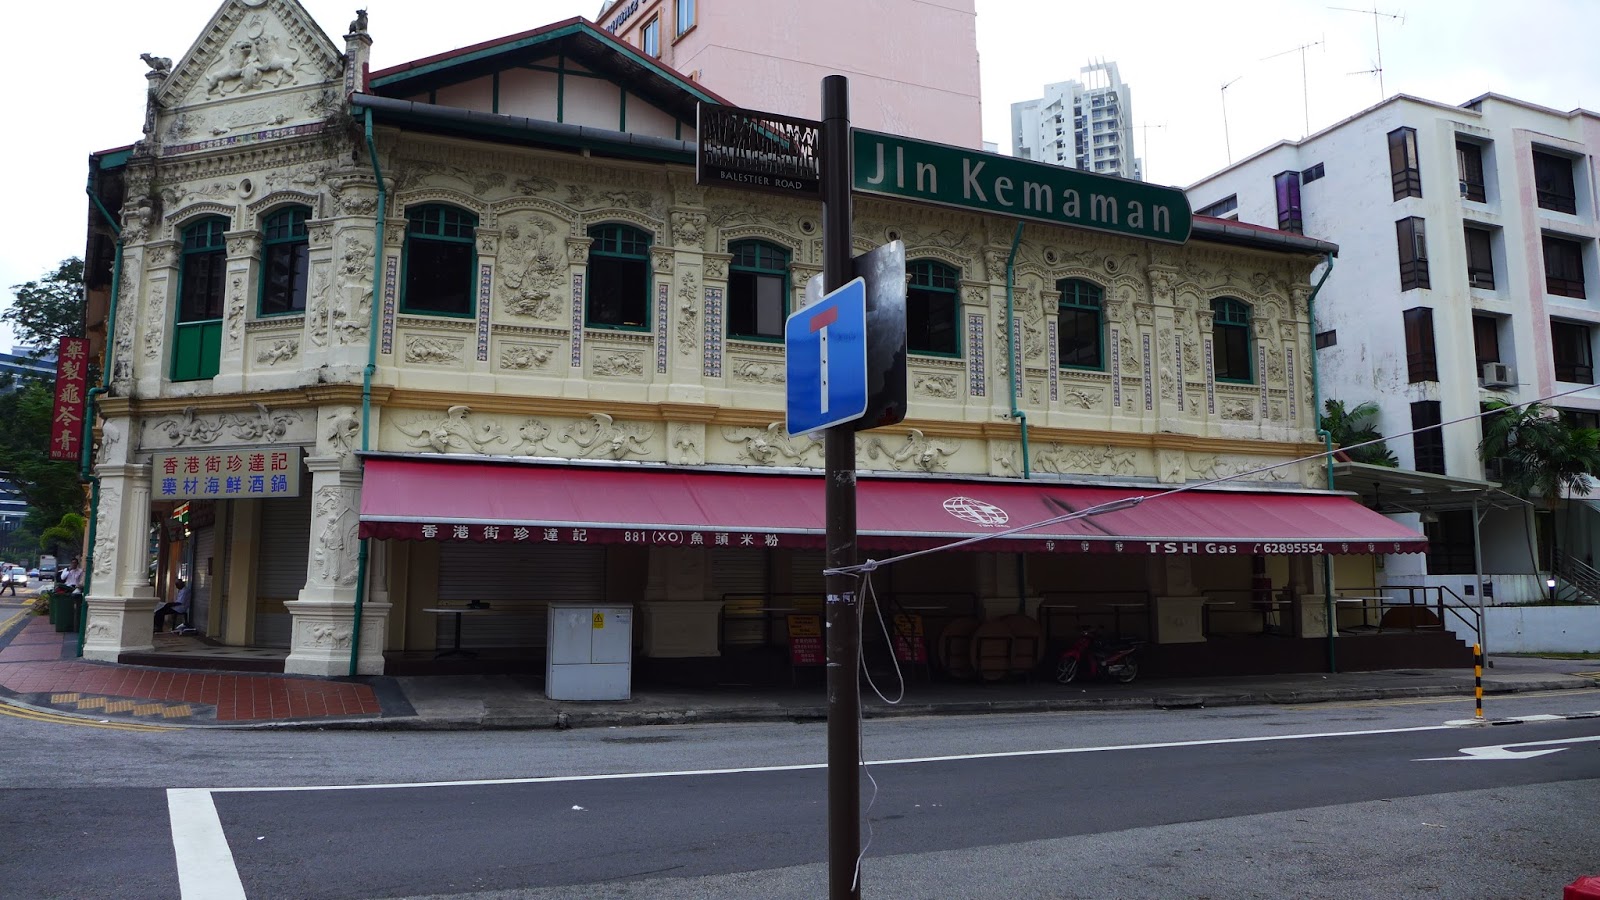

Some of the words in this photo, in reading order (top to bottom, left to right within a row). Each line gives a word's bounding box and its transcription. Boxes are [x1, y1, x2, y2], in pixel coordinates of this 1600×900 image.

[720, 171, 770, 186] BALESTIER
[775, 178, 803, 190] ROAD
[867, 142, 938, 194] Jln
[962, 157, 1170, 233] Kemaman
[163, 452, 288, 475] 香港街珍達記
[162, 474, 288, 495] 藥材海鮮酒鍋
[421, 524, 588, 542] 香港街珍達記
[1146, 542, 1198, 554] TSH
[1205, 542, 1237, 554] Gas
[1263, 543, 1324, 554] 62895554
